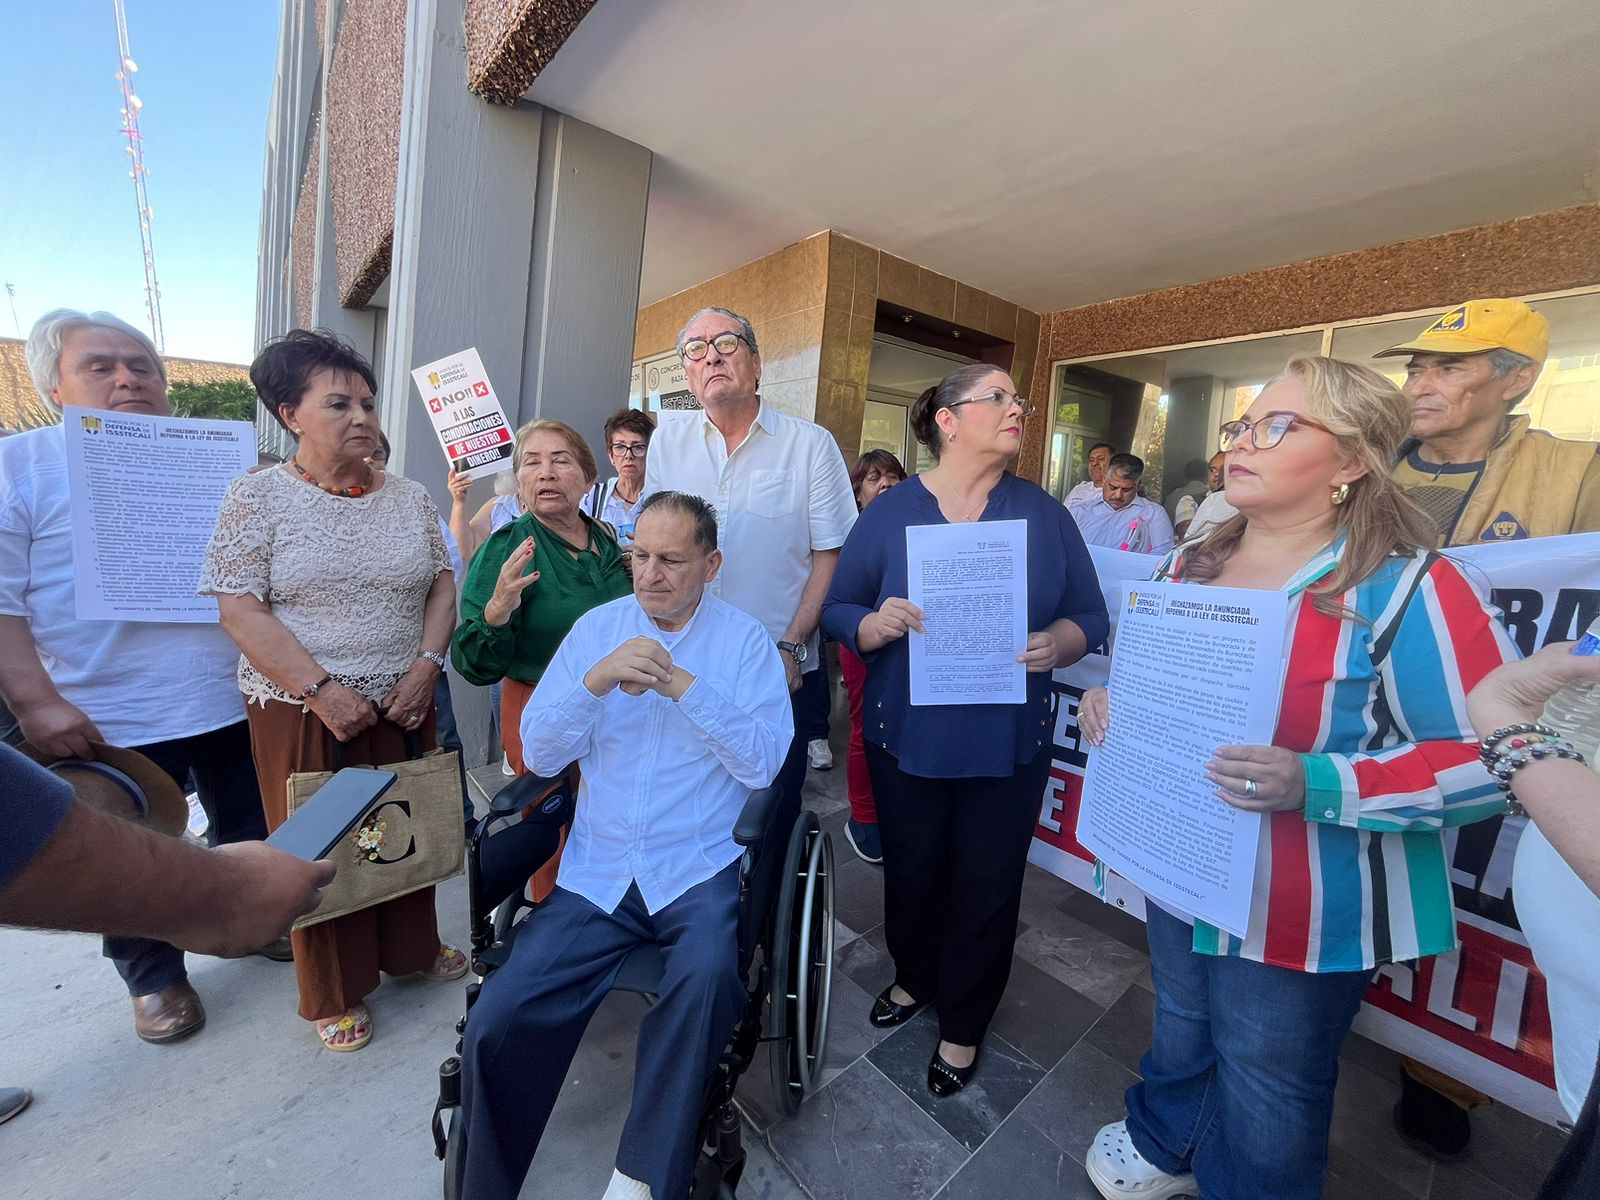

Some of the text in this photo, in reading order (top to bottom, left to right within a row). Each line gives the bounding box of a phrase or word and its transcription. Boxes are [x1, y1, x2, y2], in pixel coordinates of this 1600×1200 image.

[660, 363, 682, 374] CONGRE
[453, 406, 476, 422] A LAS
[104, 424, 142, 433] DEFENSA
[441, 414, 503, 442] CONDONACIONES
[105, 430, 152, 440] ISSSTECALI
[454, 432, 501, 455] DE NUESTRO
[466, 448, 502, 468] DINERO!!
[1166, 607, 1186, 617] REFORMA
[1186, 610, 1190, 618] A
[1191, 610, 1198, 619] LA
[1199, 612, 1210, 621] LEY
[1210, 612, 1219, 622] DE
[1204, 603, 1212, 612] LA
[1214, 604, 1250, 616] ANUNCIADA
[1187, 644, 1216, 654] Pensionados
[1225, 650, 1255, 659] Burocracia
[1212, 641, 1240, 650] Burocracia
[1221, 664, 1242, 672] cuentas
[1225, 658, 1254, 666] siguientes
[1227, 683, 1250, 692] contable
[1196, 711, 1226, 723] aportaciones
[1221, 710, 1236, 718] todos
[1208, 728, 1230, 737] contrato
[1208, 811, 1230, 822] corazón
[360, 800, 416, 865] C
[1214, 832, 1233, 844] Pesos)
[1145, 868, 1166, 882] DEFENSA
